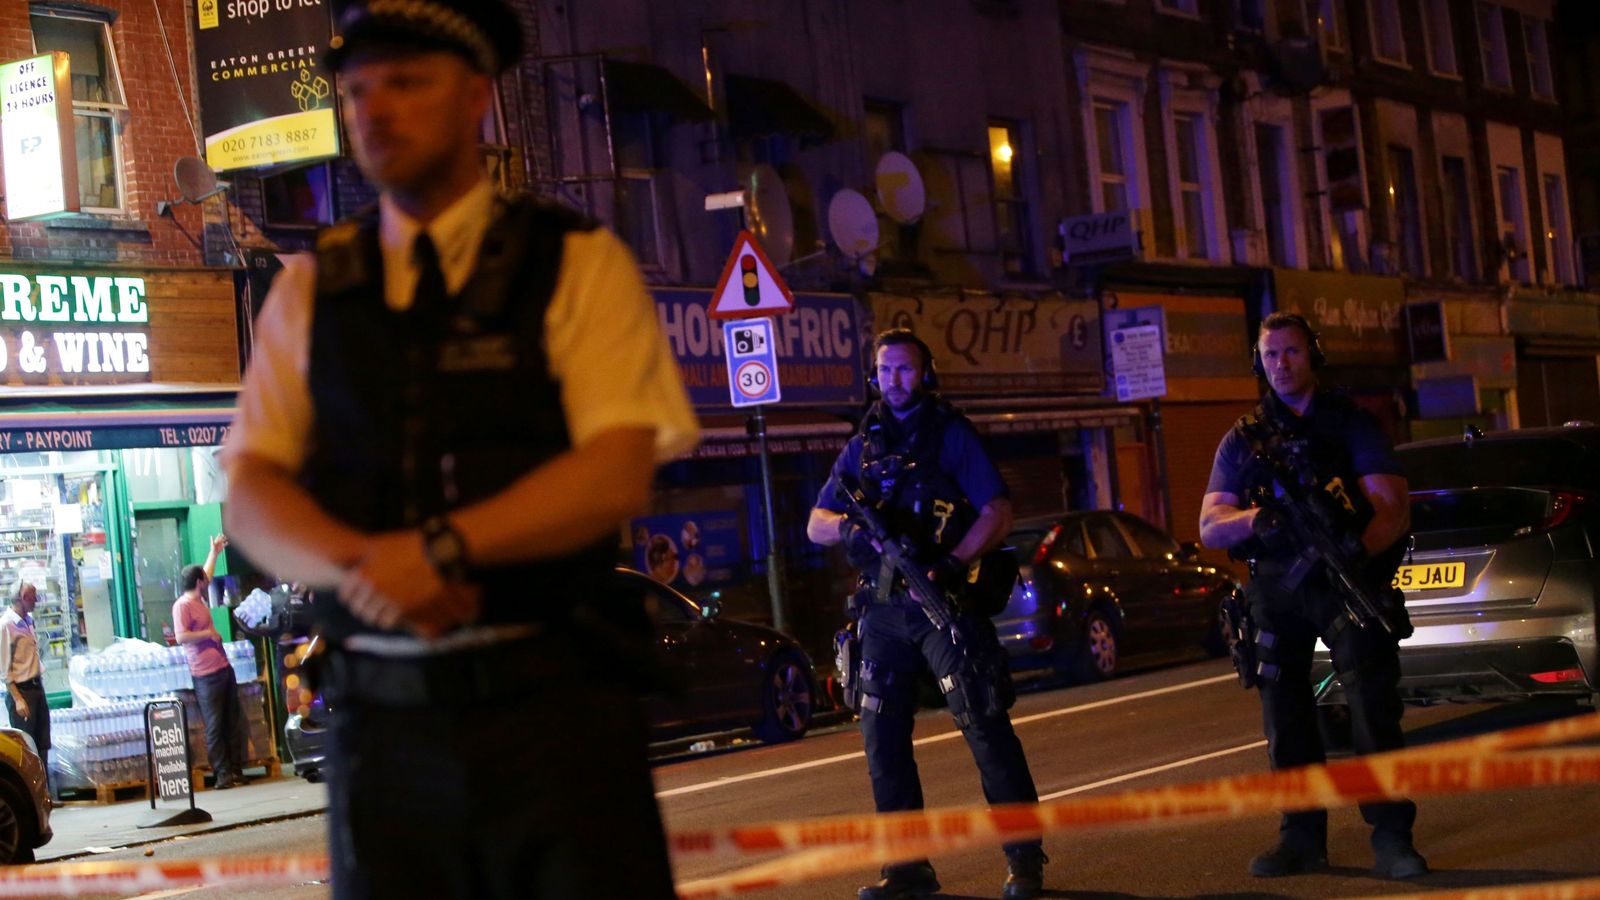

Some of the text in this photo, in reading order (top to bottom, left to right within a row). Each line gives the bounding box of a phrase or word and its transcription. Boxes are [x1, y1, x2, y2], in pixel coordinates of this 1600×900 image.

[227, 0, 270, 19] shop
[211, 45, 316, 69] EATON GREEN
[19, 62, 35, 75] OFF
[211, 58, 316, 81] COMMERCIAL
[10, 76, 47, 94] LICENCE
[22, 91, 54, 109] HOURS
[222, 128, 317, 153] 020 7183 8887
[0, 273, 148, 322] REME
[945, 308, 1036, 367] QHP
[18, 330, 47, 373] &
[54, 332, 149, 373] WINE
[742, 371, 766, 387] 30
[26, 430, 92, 449] PAYPOINT
[188, 425, 217, 444] 0207
[1419, 566, 1456, 585] JAU
[152, 722, 183, 746] Cash
[156, 743, 185, 758] machine
[158, 760, 187, 774] Available
[160, 775, 190, 797] here
